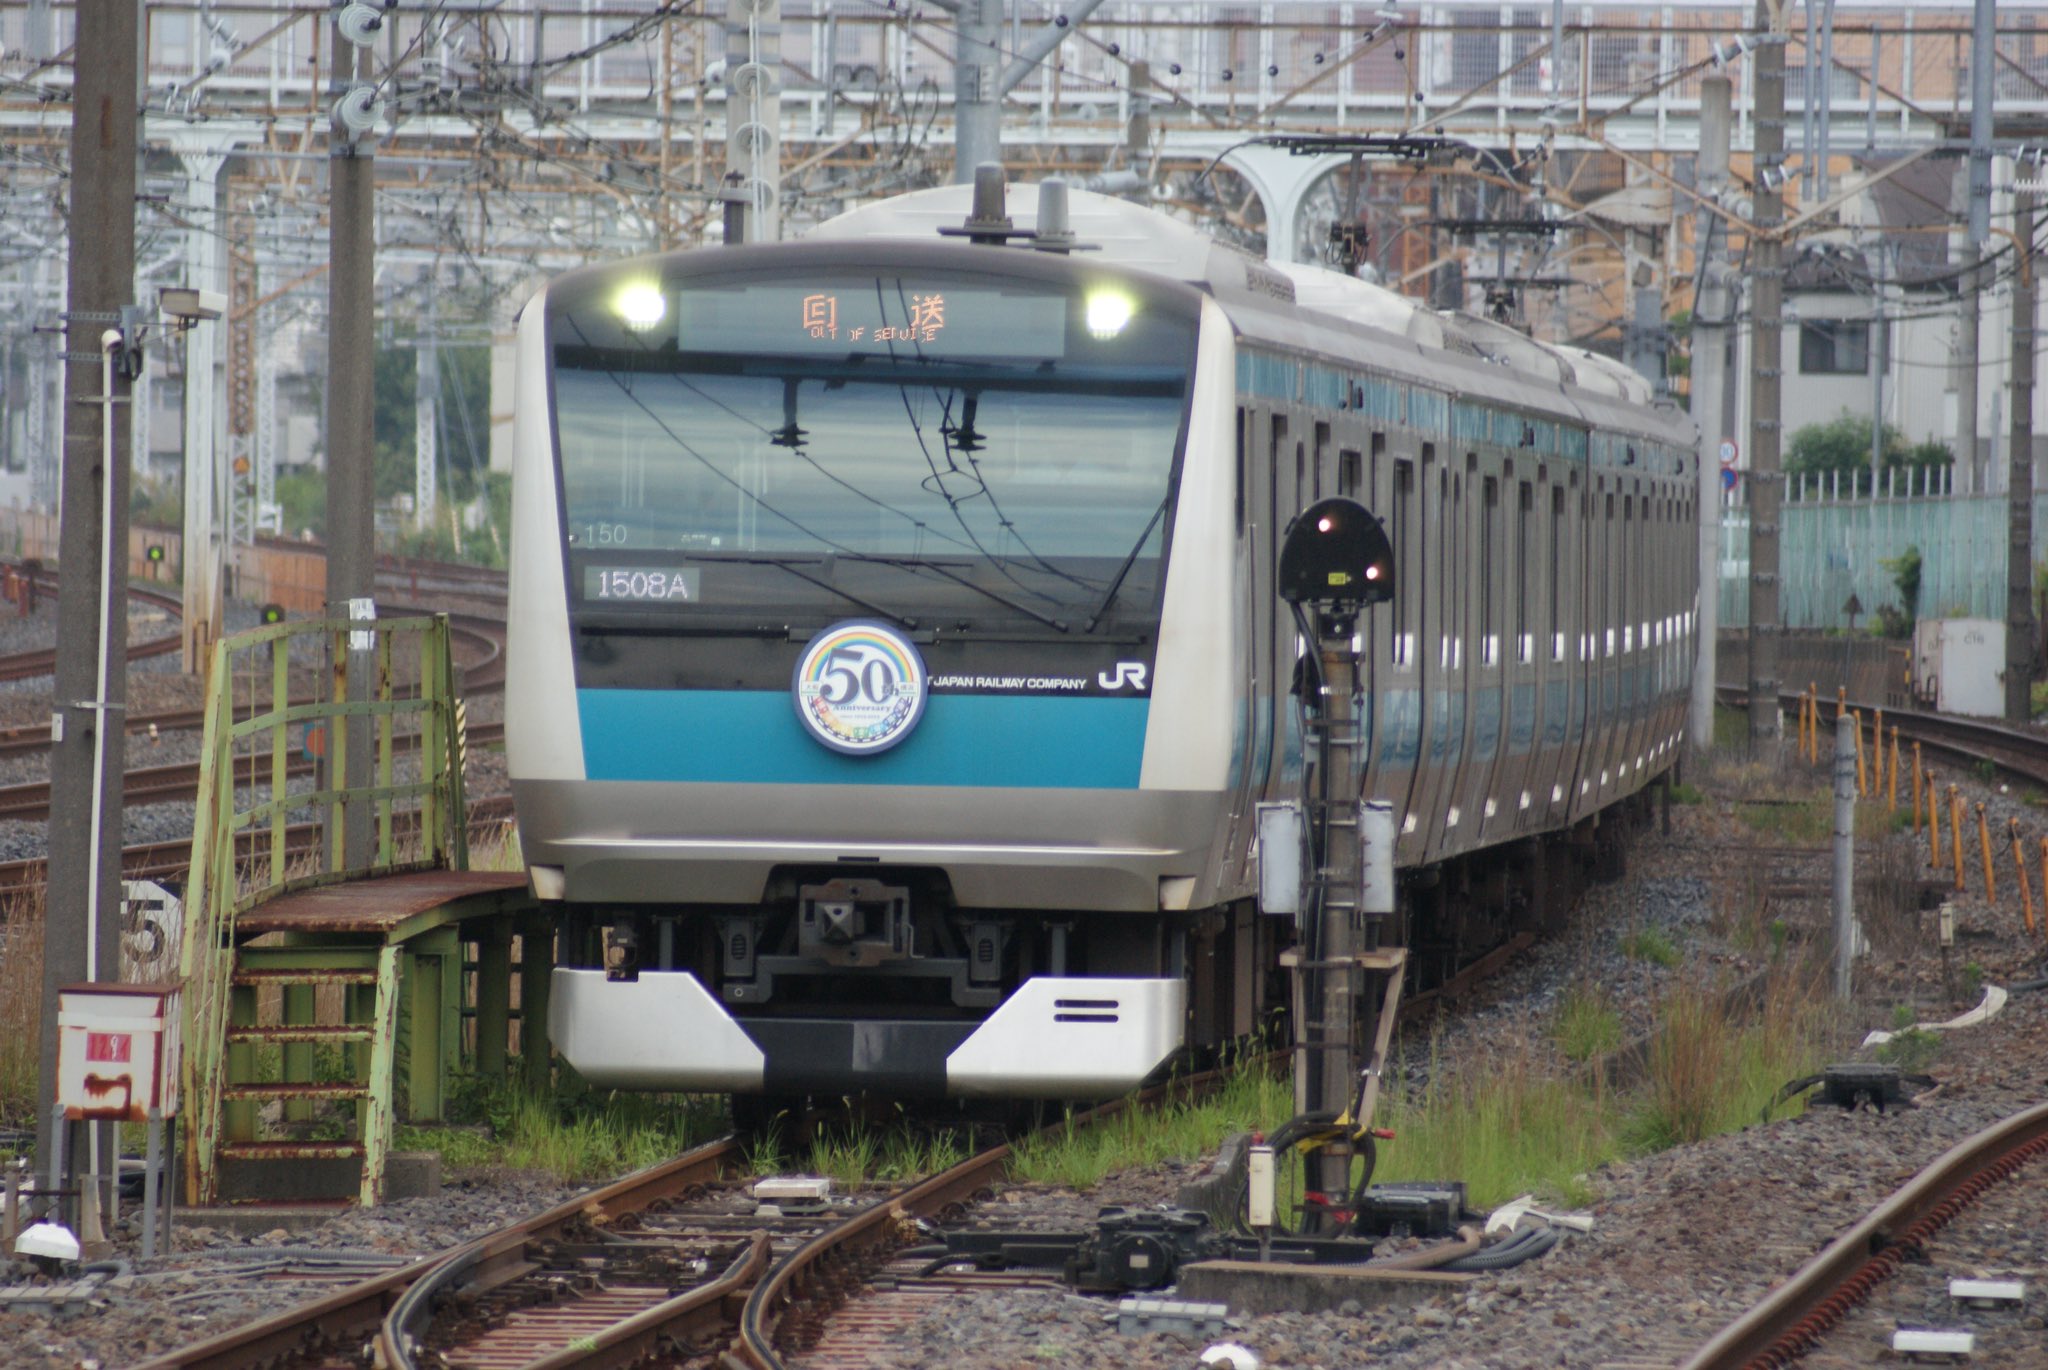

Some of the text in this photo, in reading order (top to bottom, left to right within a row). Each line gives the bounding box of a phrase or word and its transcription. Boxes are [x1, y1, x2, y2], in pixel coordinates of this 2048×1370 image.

[585, 524, 627, 544] 150
[598, 571, 688, 599] 1508A
[820, 647, 893, 705] 50
[933, 676, 973, 687] JAPAN
[976, 677, 1025, 688] RAILWAY
[1027, 677, 1087, 689] COMPANY
[1098, 662, 1146, 690] JR
